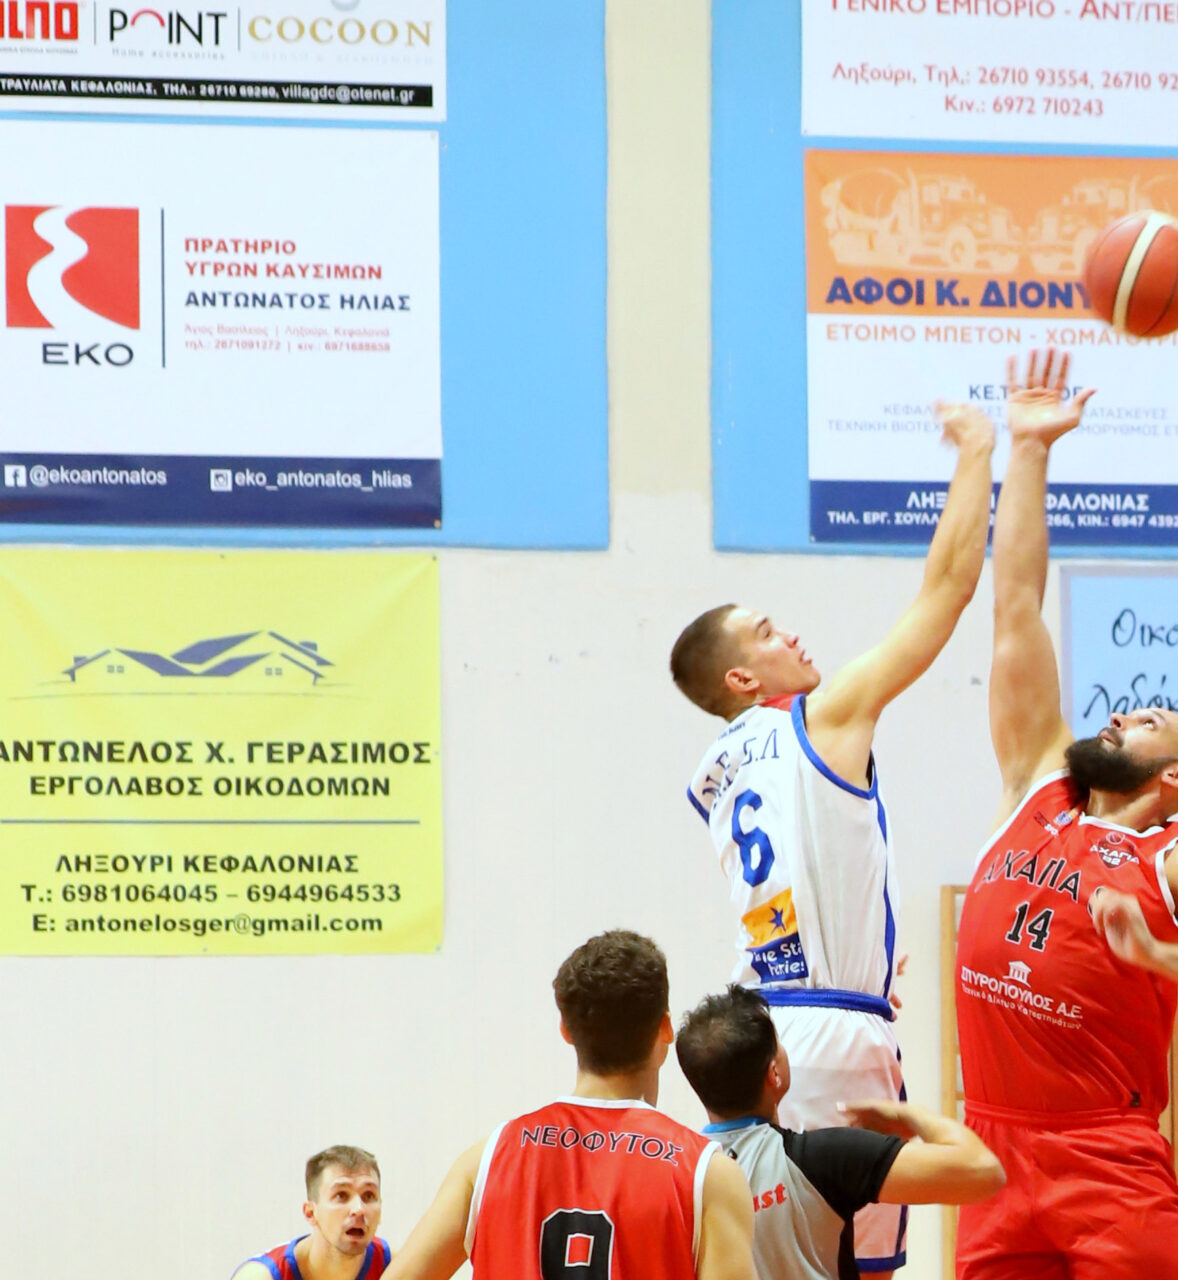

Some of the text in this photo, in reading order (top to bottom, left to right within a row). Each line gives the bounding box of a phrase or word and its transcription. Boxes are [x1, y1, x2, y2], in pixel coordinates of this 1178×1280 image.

[248, 15, 432, 47] COCOON
[832, 62, 917, 85] Ληξούρι,
[978, 66, 1029, 85] 26710
[1036, 69, 1095, 90] 93554,
[1101, 71, 1151, 90] 26710
[992, 96, 1036, 115] 6972
[1043, 99, 1105, 117] 710243
[184, 237, 297, 255] ΠΡΑΤΗΡΙΟ
[185, 260, 383, 281] ΥΓΡΩΝ ΚΑΥΣΙΜΩΝ
[185, 291, 412, 311] ΑΝΤΩΝΑΤΟΣ ΗΛΙΑΣ
[826, 276, 925, 306] ΑΦΟΙ
[935, 279, 970, 307] Κ.
[826, 323, 917, 343] ΕΤΟΙΜΟ
[924, 325, 1022, 344] ΜΠΕΤΟΝ
[42, 342, 135, 366] EKO
[29, 464, 168, 486] @ekoantonatos
[205, 741, 235, 764] Χ.
[247, 741, 432, 765] ΓΕΡΑΣΙΜΟΣ
[30, 776, 391, 797] ΕΡΓΟΛΑΒΟΣ ΟΙΚΟΔΟΜΩΝ
[731, 788, 775, 888] 6
[56, 855, 359, 873] ΛΗΞΟΥΡΙ ΚΕΦΑΛΟΝΙΑΣ
[21, 884, 402, 903] Τ.: 6981064045 6944964533
[32, 912, 383, 937] E: antonelosger@gmail.com
[1005, 901, 1055, 953] 14
[520, 1125, 684, 1167] ΝΕΟΦΥΤΟΣ
